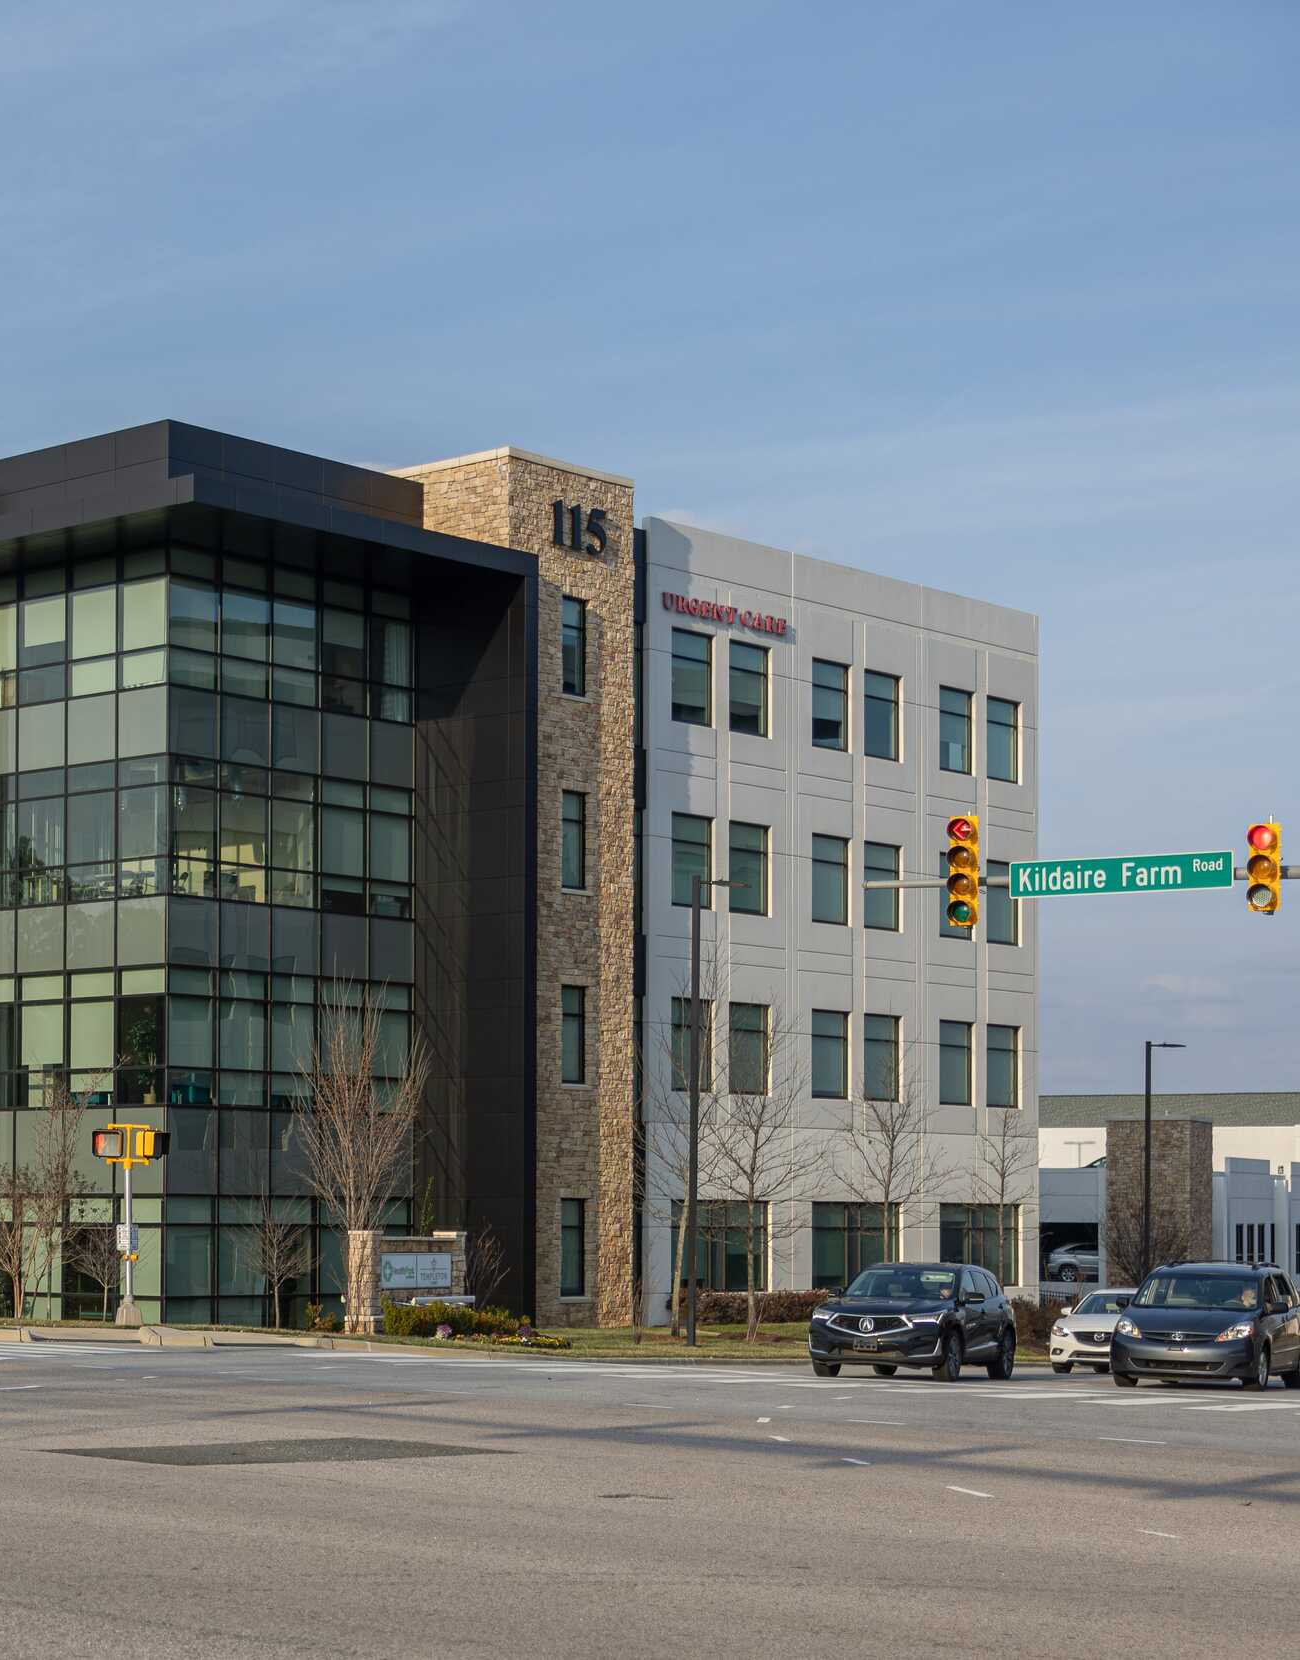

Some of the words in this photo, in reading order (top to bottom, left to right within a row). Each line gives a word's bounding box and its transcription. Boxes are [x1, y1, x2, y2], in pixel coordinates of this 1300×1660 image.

[552, 499, 607, 557] 115
[662, 592, 737, 625] URGENT
[739, 610, 787, 635] CARE
[1018, 864, 1107, 893] Kildaire
[1121, 862, 1182, 888] Farm
[1192, 857, 1224, 873] Road
